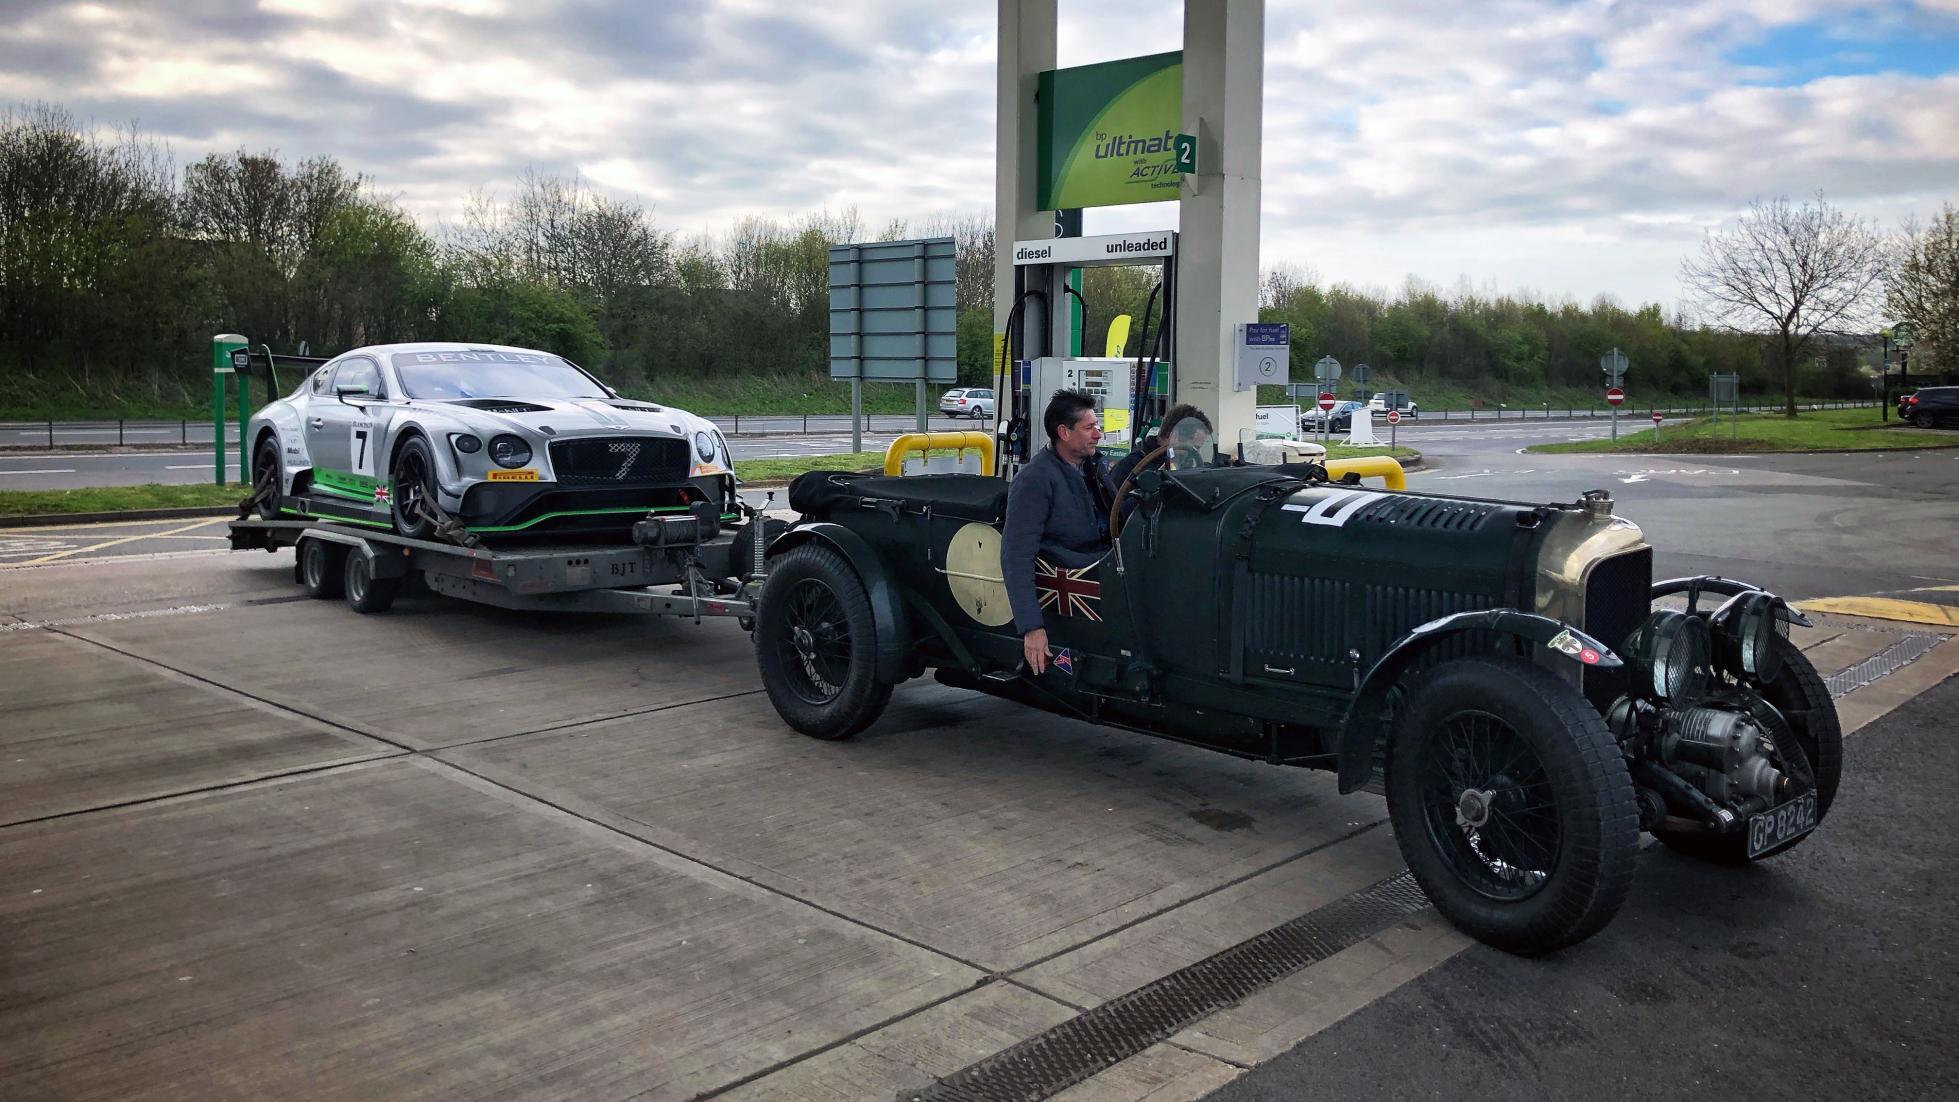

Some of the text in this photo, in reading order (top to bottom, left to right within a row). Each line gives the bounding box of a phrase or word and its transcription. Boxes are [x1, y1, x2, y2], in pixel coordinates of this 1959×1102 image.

[1096, 131, 1107, 142] bp
[1181, 142, 1191, 164] 2
[1151, 180, 1181, 189] technolog
[1016, 238, 1167, 260] diesel unleaded
[417, 351, 550, 365] BENTLEY
[1067, 369, 1073, 377] 2
[1264, 361, 1271, 372] 2
[355, 430, 368, 469] 7
[608, 442, 641, 480] 7
[492, 471, 534, 480] PIRELLI
[611, 562, 637, 576] BJT
[1584, 651, 1595, 660] 5
[1753, 797, 1814, 851] GP 8242
